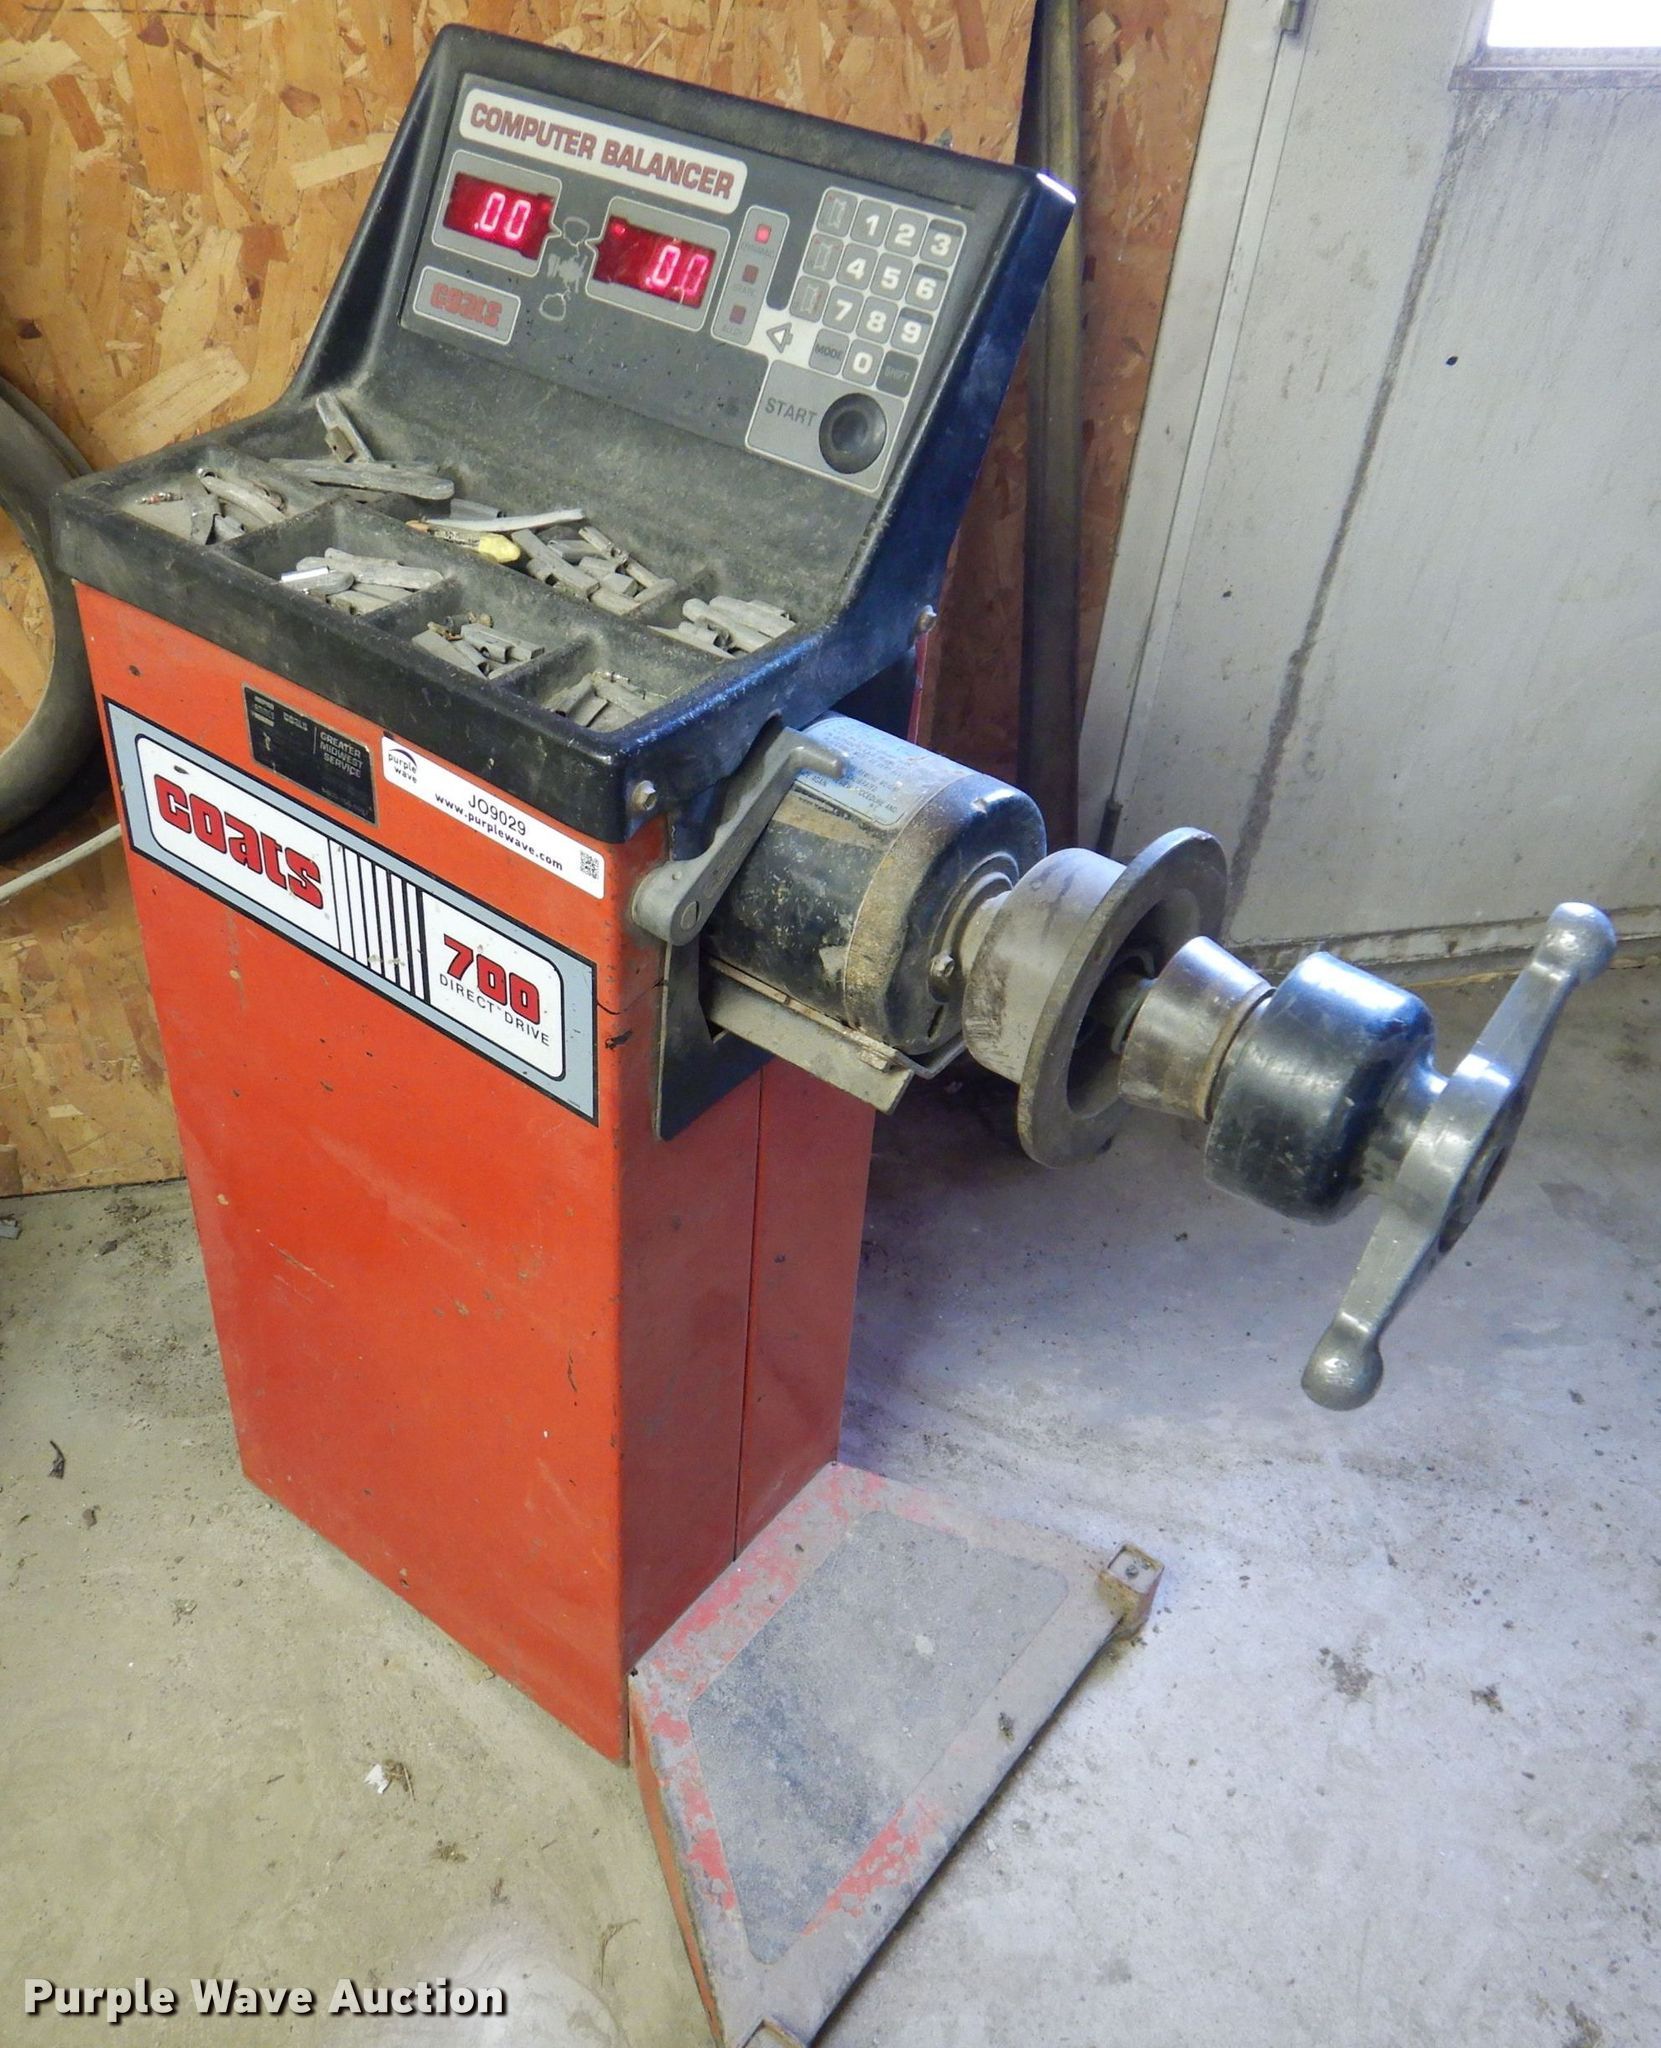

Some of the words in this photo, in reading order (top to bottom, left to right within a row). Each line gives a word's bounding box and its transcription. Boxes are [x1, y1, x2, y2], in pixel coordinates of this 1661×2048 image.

[470, 102, 597, 160] COMPUTER
[600, 139, 735, 200] BALANCER
[866, 214, 880, 236] 1
[894, 223, 916, 247] 2
[930, 233, 952, 257] 3
[846, 257, 866, 280] 4
[881, 266, 901, 290] 5
[915, 277, 937, 301] 6
[835, 300, 853, 321] 7
[866, 310, 887, 334] 8
[901, 321, 922, 344] 9
[853, 352, 873, 374] 0
[765, 396, 818, 426] START
[320, 732, 361, 757] GREATER
[320, 741, 363, 769] MIDWEST
[324, 752, 361, 778] SERVICE
[387, 752, 418, 775] purple
[394, 765, 418, 784] wave
[434, 792, 563, 871] www.purplewave.com
[443, 933, 540, 1025] 700
[439, 974, 496, 1014] DIRECT
[504, 1011, 550, 1047] DRIVE
